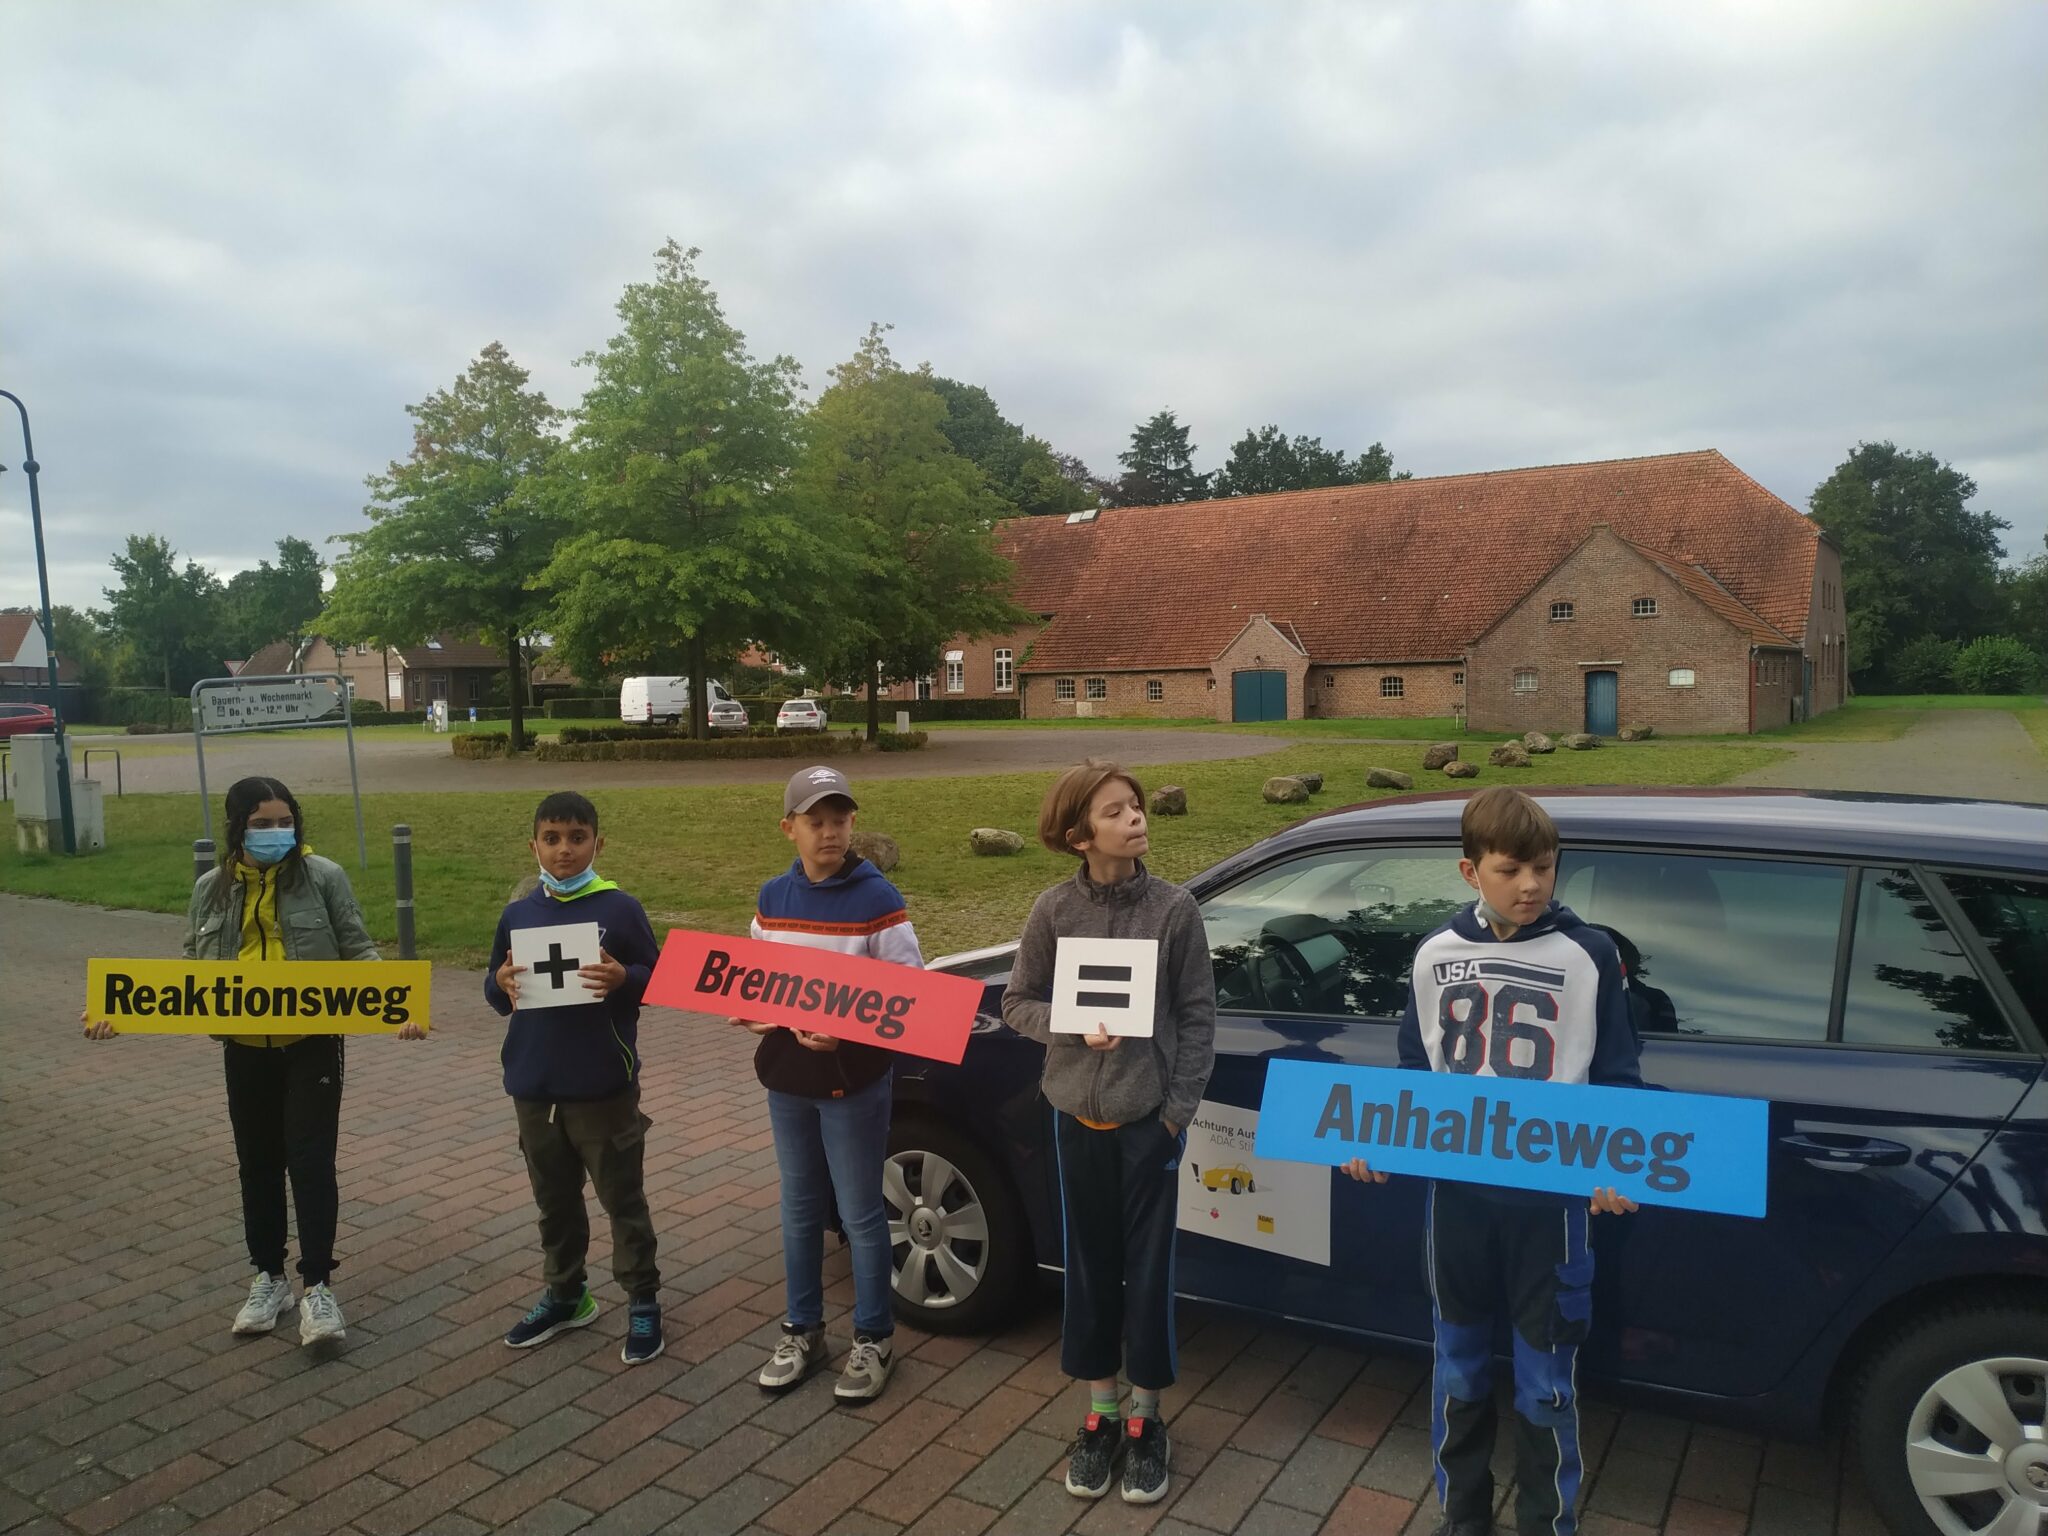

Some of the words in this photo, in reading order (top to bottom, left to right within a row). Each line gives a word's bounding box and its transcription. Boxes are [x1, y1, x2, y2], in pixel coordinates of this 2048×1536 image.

[260, 691, 313, 703] Wochenmarkt
[285, 705, 299, 713] Uhr
[1434, 960, 1481, 984] USA
[104, 973, 412, 1025] Reaktionsweg
[694, 950, 916, 1040] Bremsweg
[1438, 982, 1560, 1081] 86
[1192, 1118, 1235, 1137] Achtung
[1236, 1127, 1256, 1140] Aut
[1314, 1083, 1695, 1193] Anhalteweg
[1209, 1134, 1236, 1149] ADAC
[1239, 1140, 1256, 1152] Stif
